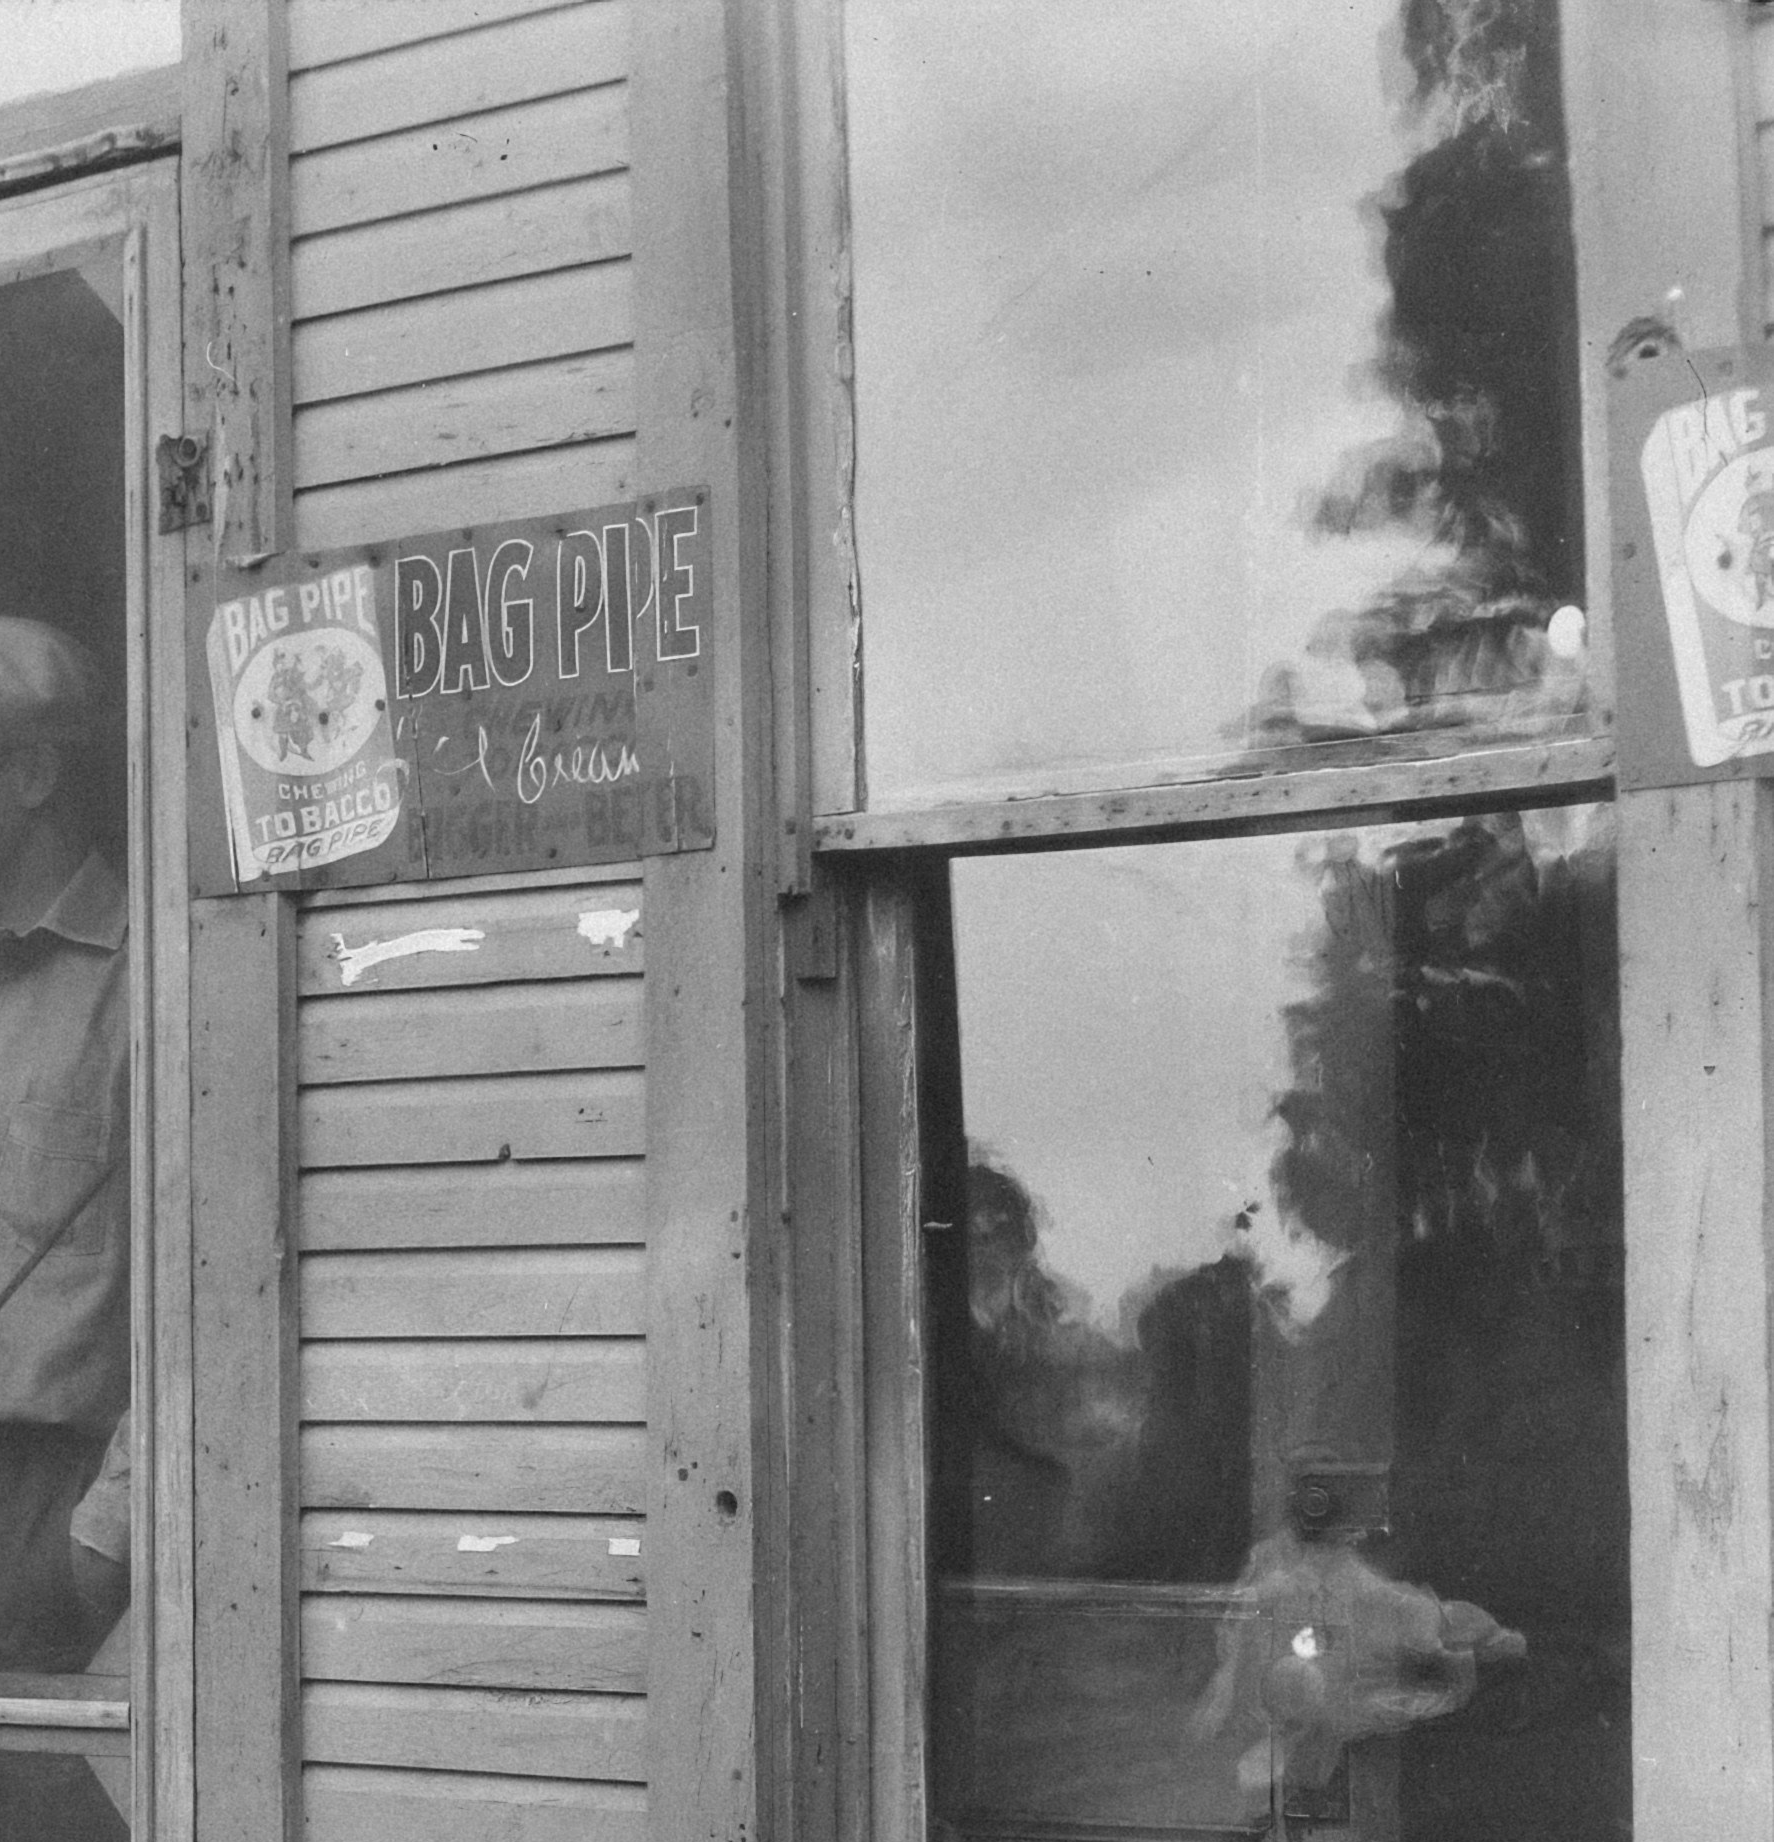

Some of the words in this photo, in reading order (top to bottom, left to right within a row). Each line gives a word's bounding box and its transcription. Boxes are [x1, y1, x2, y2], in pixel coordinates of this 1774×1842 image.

[217, 588, 290, 676] BAG
[301, 564, 376, 634] PIPE
[395, 538, 535, 700] BAG
[557, 506, 700, 679] PIPE
[256, 780, 393, 838] TOBACCO
[278, 761, 366, 800] CHEWING
